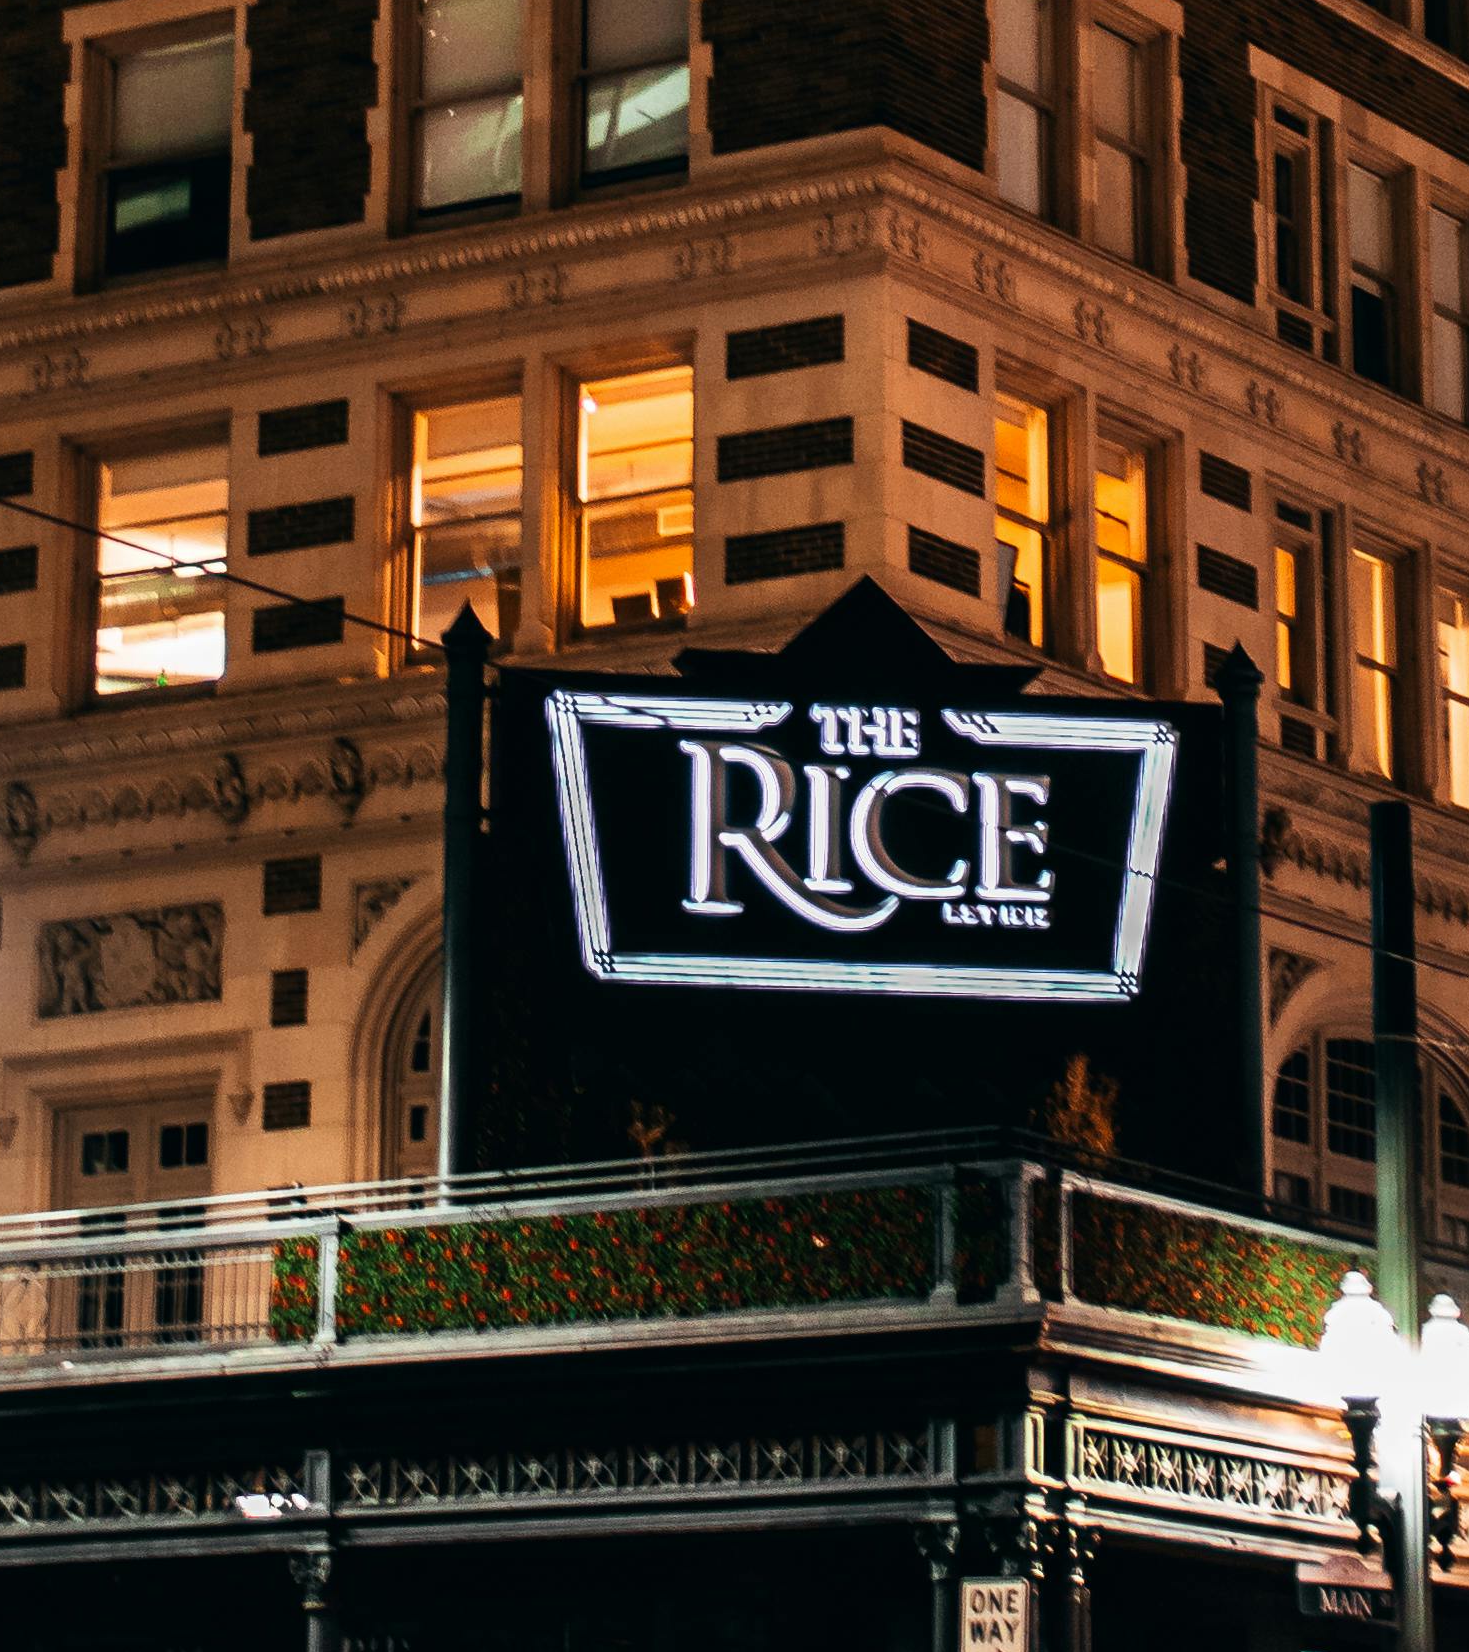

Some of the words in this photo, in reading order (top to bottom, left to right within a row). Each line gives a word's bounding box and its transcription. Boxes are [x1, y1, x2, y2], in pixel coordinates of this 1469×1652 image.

[809, 703, 920, 758] THE
[679, 739, 1054, 933] RICE
[969, 1587, 1020, 1614] ONE
[1318, 1586, 1373, 1620] MAIN
[968, 1618, 1021, 1644] WAY
